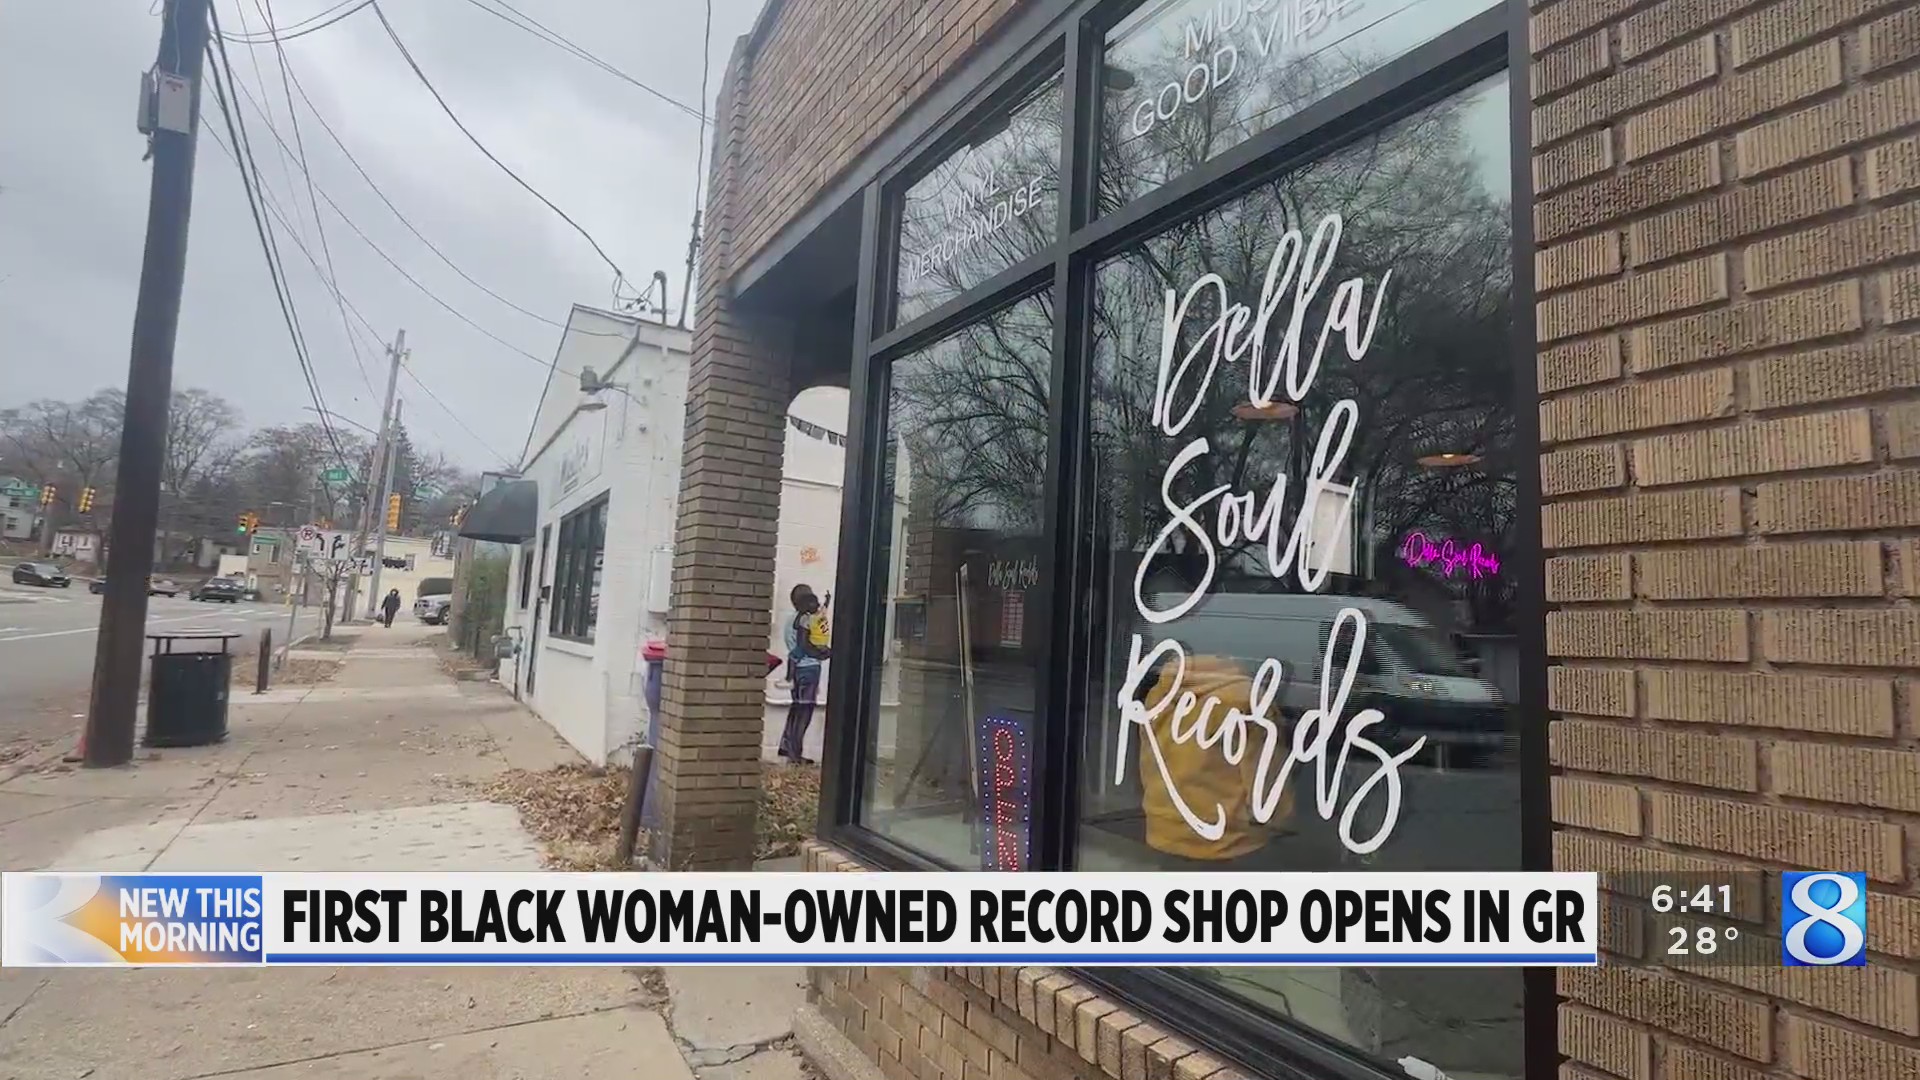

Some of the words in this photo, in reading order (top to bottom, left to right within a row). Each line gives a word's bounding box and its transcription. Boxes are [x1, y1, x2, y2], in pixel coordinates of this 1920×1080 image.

[1132, 45, 1237, 136] GOOD
[908, 175, 1043, 284] MERCHANDISE
[946, 170, 1000, 224] VINYL
[1152, 213, 1393, 437] Della
[1134, 399, 1359, 623] Soul
[994, 728, 1019, 872] OPEN
[1114, 608, 1427, 854] Records
